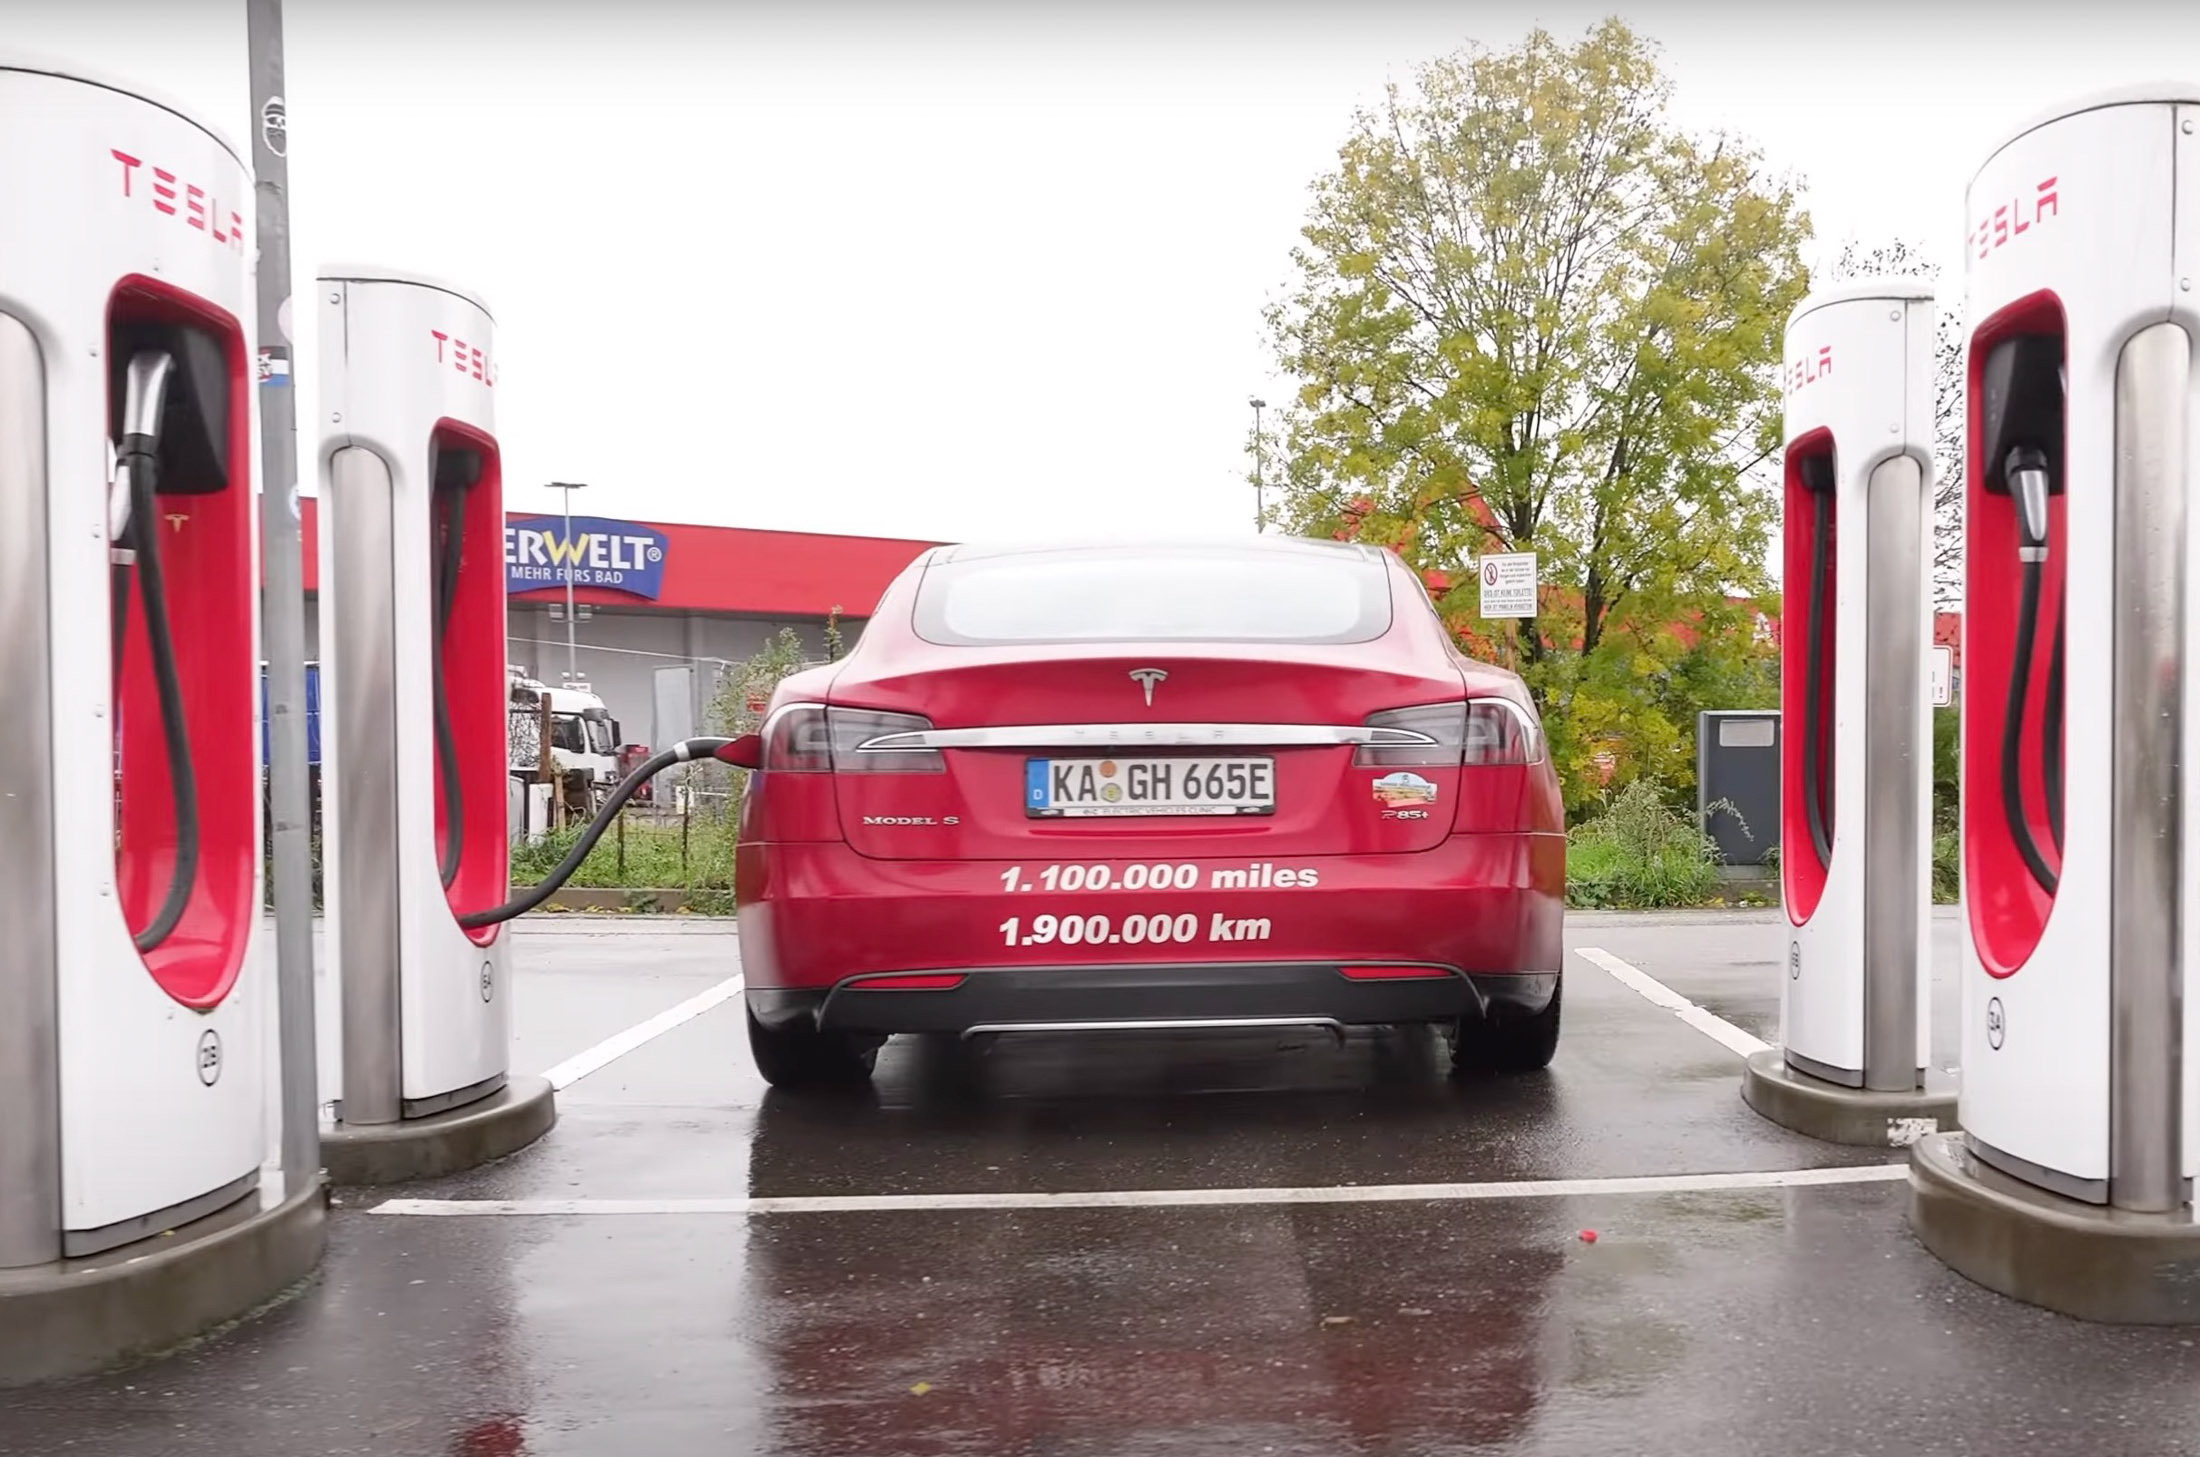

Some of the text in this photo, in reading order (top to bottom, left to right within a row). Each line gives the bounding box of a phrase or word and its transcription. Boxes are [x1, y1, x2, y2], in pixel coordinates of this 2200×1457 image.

[110, 148, 243, 256] TESLA
[1788, 345, 1831, 396] ESLA
[511, 565, 552, 581] MEHR
[595, 570, 623, 584] BAD
[1033, 788, 1044, 800] D
[1053, 763, 1270, 802] KA GH 665E
[862, 815, 960, 826] MODEL S
[1000, 862, 1319, 892] 1.100.000 miles
[999, 912, 1271, 946] 1.900.000 km
